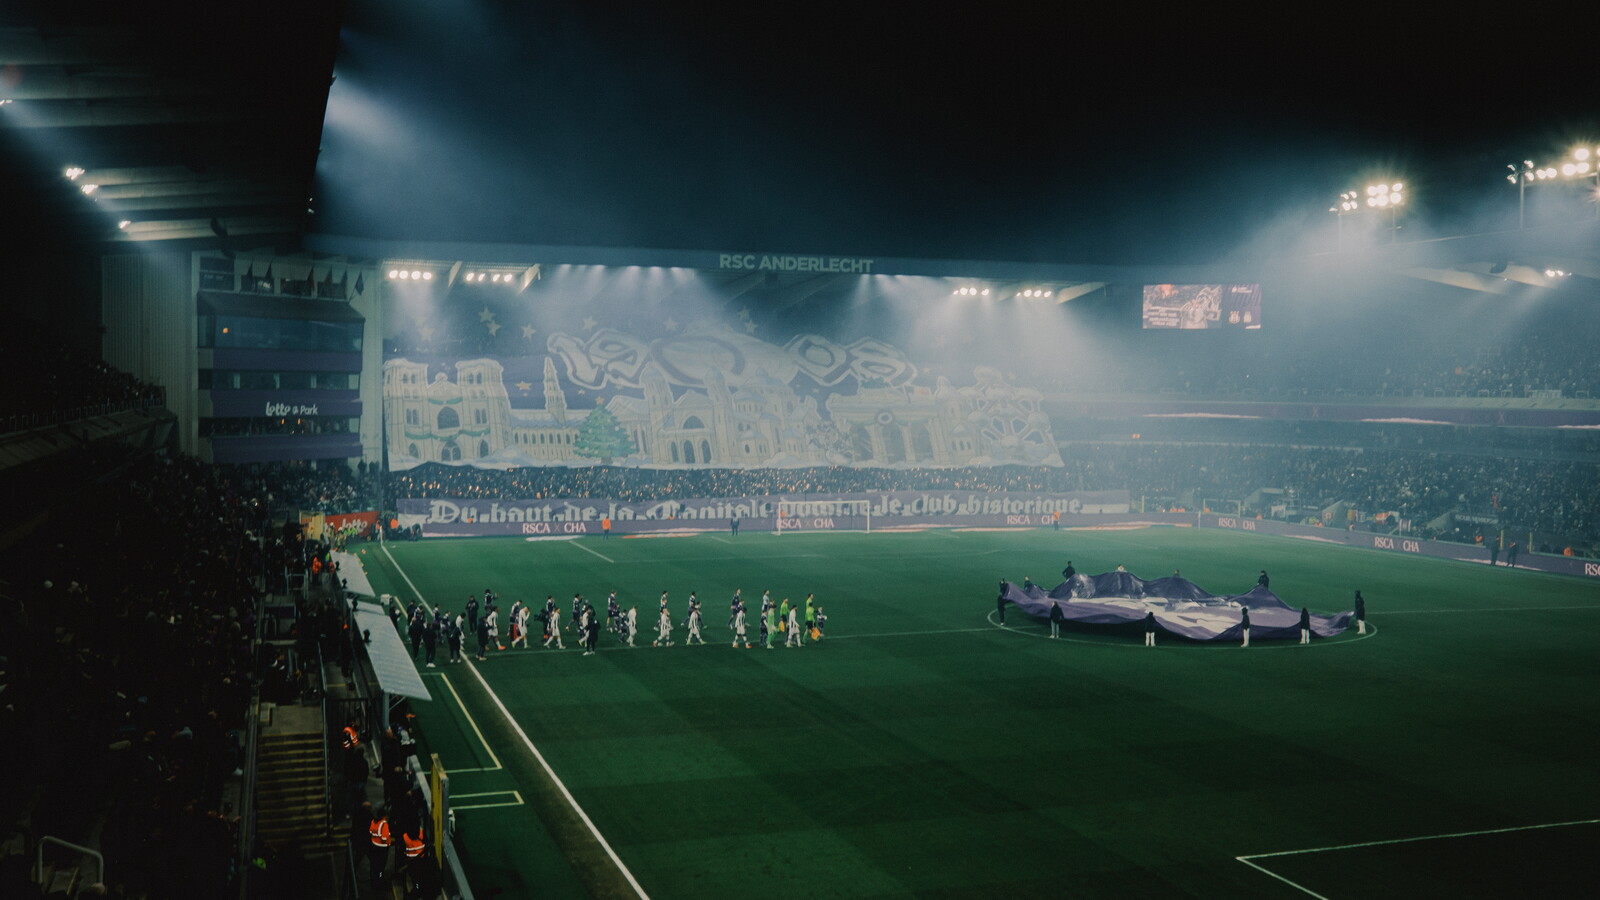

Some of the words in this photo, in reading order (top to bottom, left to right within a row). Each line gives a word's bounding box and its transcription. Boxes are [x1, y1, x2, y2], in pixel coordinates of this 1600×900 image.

[719, 254, 755, 269] RSC
[759, 256, 874, 273] ANDERLECHT
[300, 404, 318, 416] Park
[911, 494, 957, 516] club
[776, 518, 802, 529] RSCA
[813, 518, 834, 528] CHA
[1007, 515, 1030, 525] RSCA
[1218, 518, 1236, 528] RSCA
[1242, 520, 1256, 530] CHA
[522, 523, 550, 534] RSCA
[563, 523, 586, 533] CHA
[1374, 537, 1394, 549] RSCA
[1403, 540, 1419, 552] CHA
